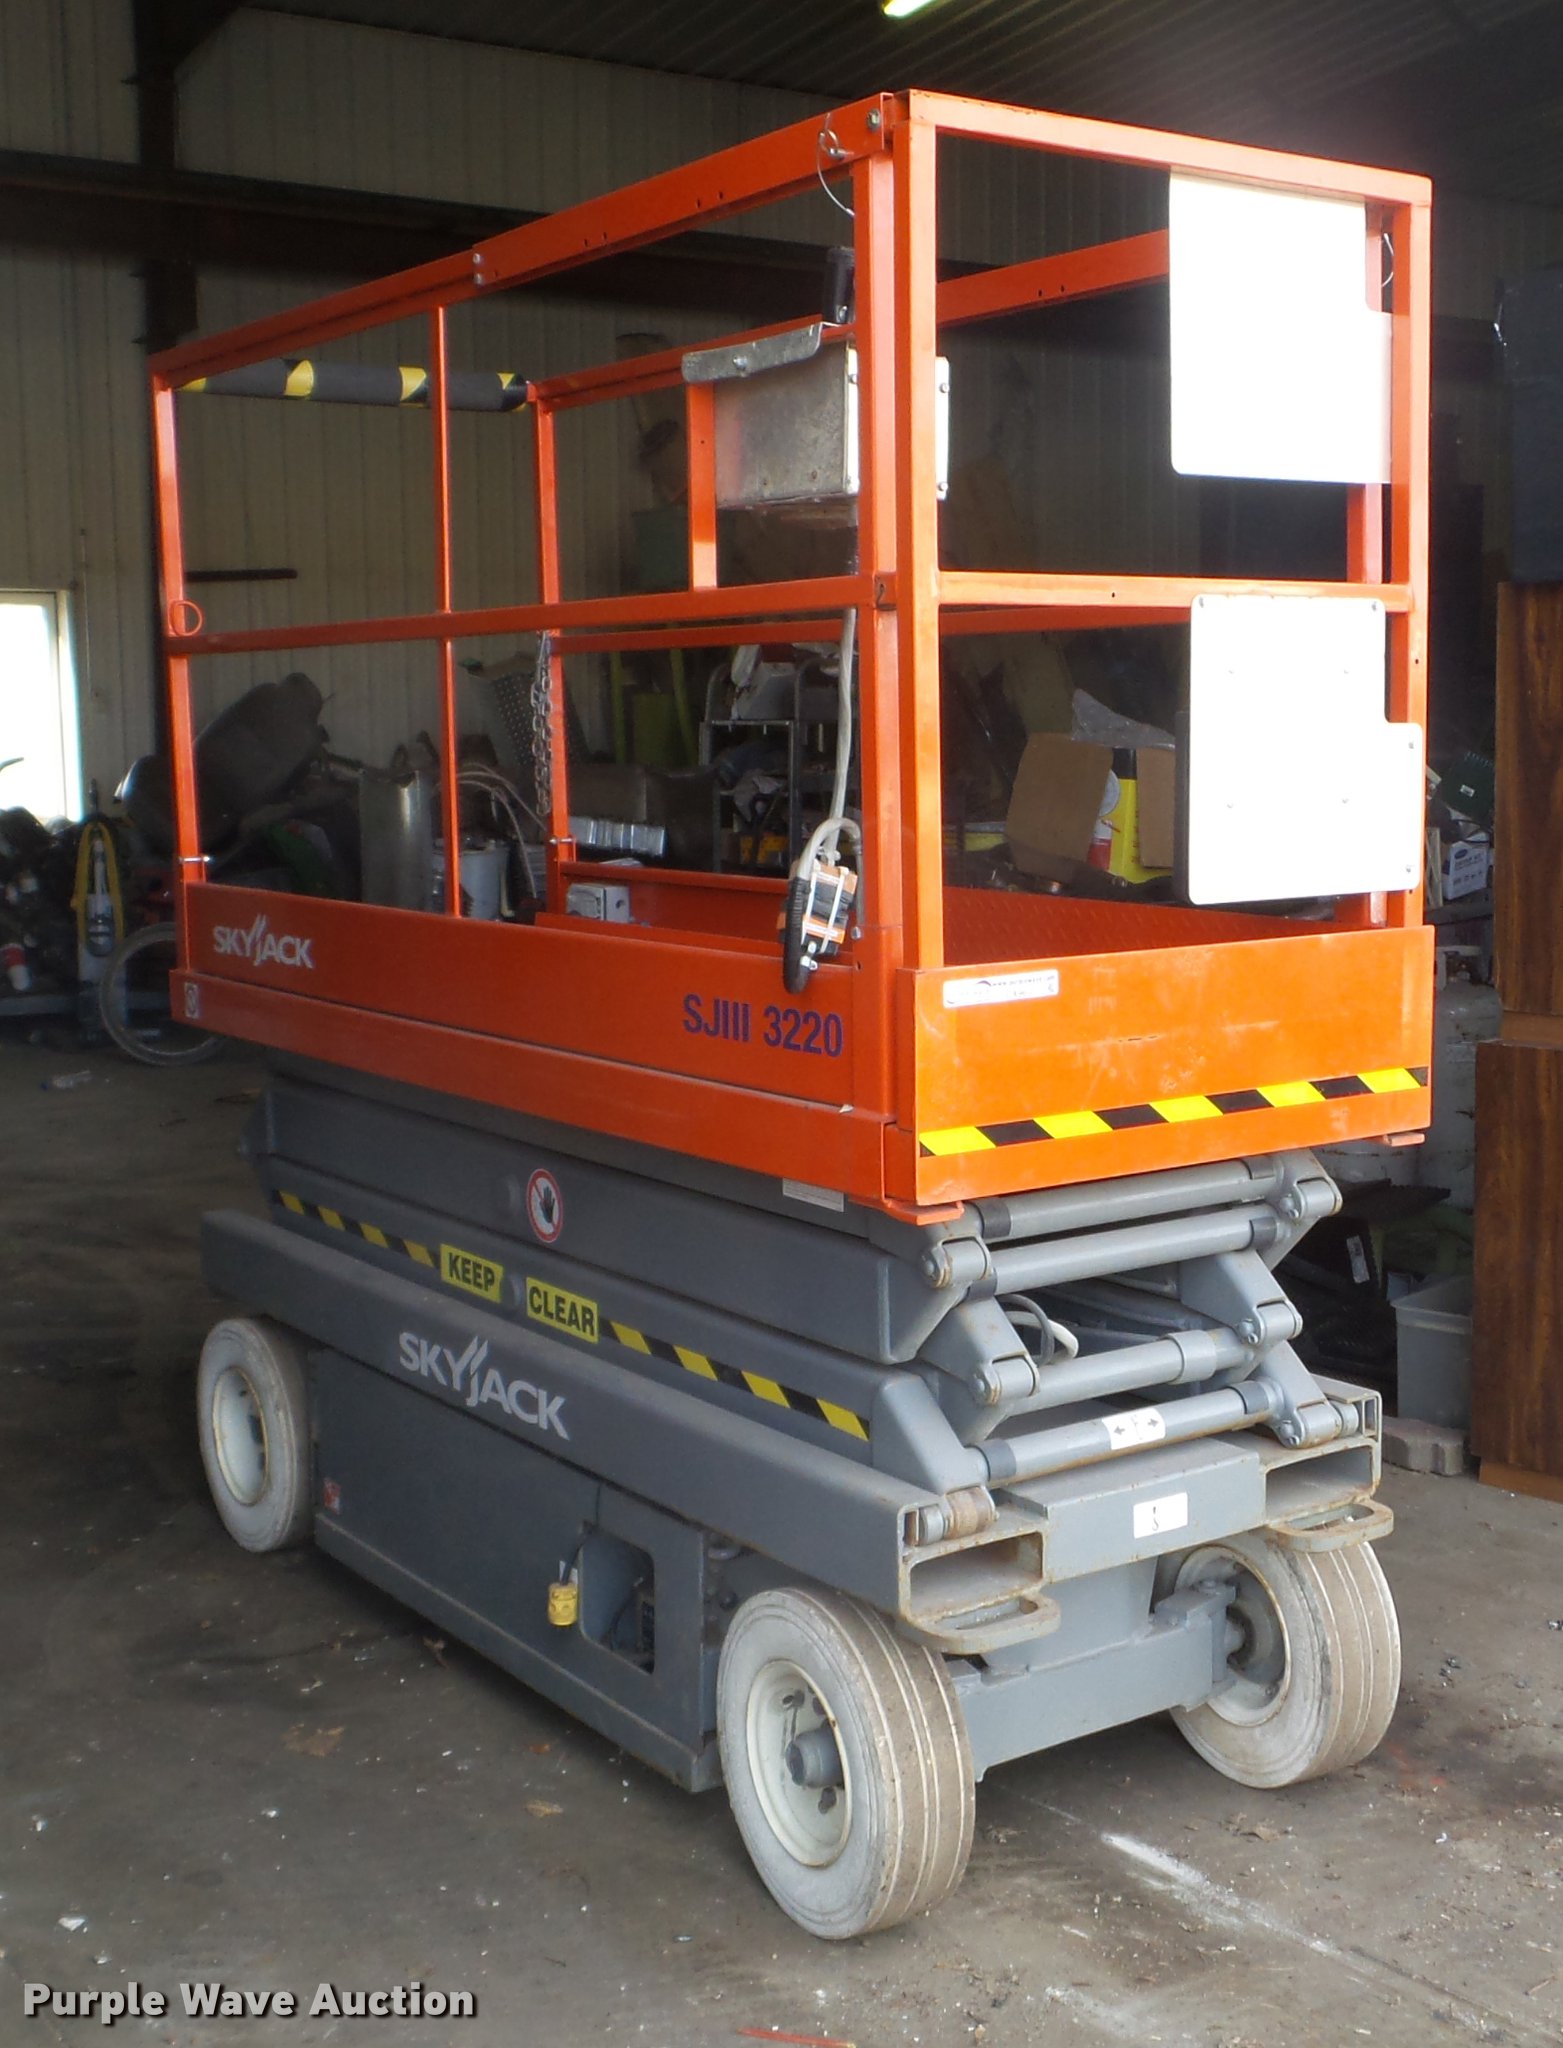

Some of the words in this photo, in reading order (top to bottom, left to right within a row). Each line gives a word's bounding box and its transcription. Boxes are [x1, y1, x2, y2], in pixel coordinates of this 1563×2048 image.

[213, 914, 314, 969] SKYJACK
[763, 1005, 843, 1058] 3220
[448, 1251, 496, 1293] KEEP
[528, 1285, 597, 1337] CLEAR
[399, 1332, 570, 1441] SKYJACK
